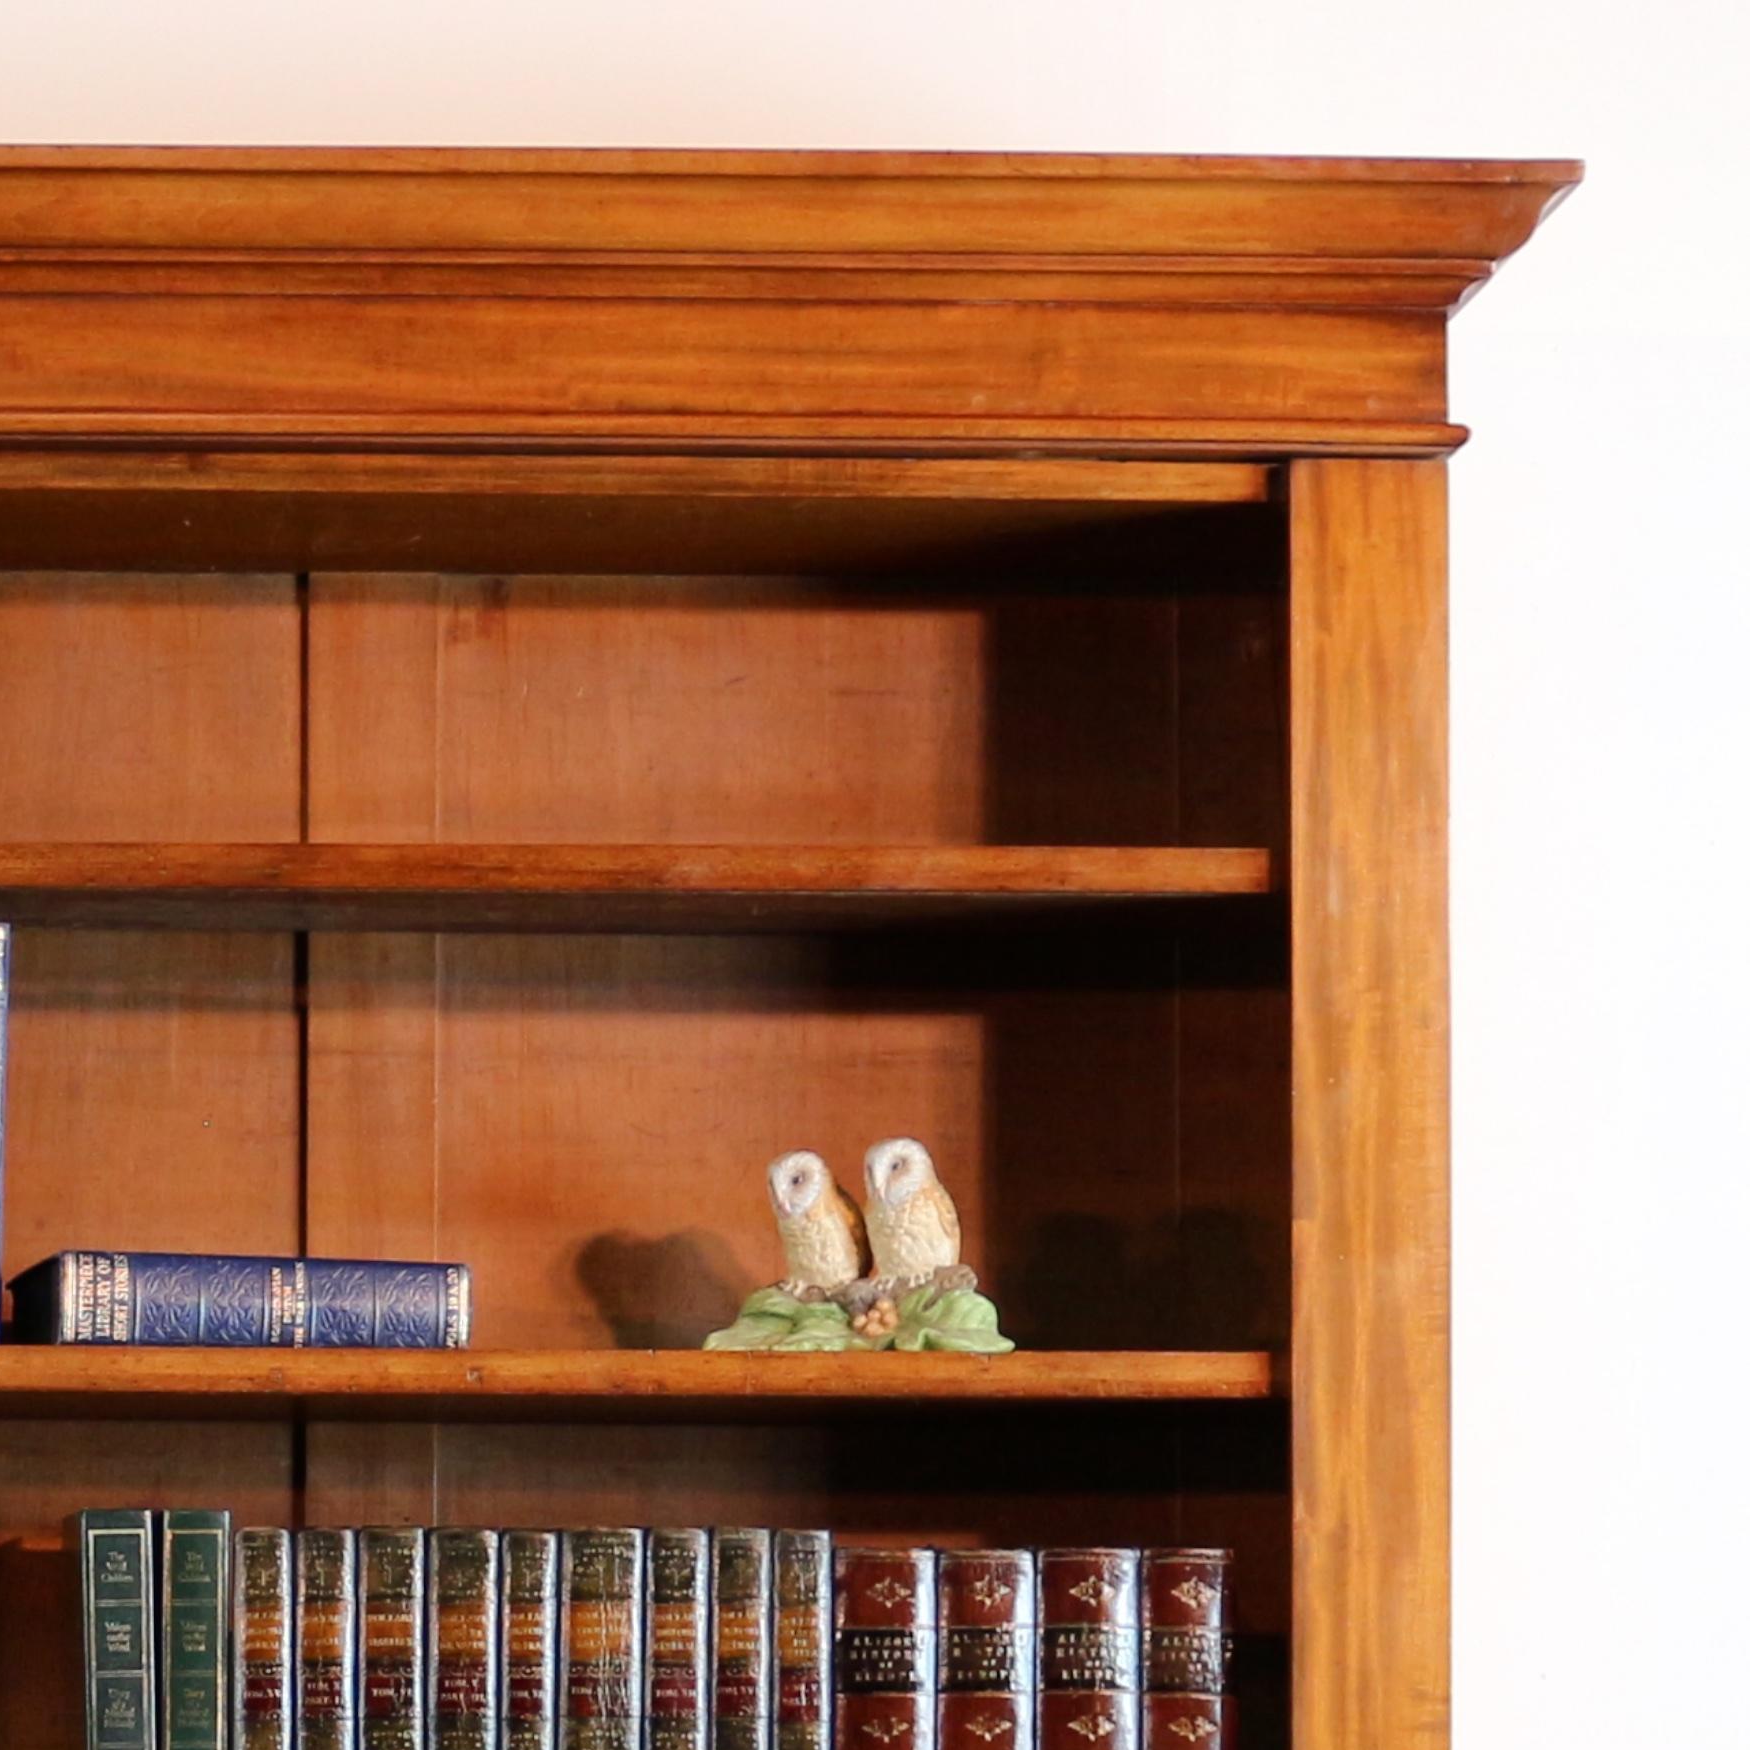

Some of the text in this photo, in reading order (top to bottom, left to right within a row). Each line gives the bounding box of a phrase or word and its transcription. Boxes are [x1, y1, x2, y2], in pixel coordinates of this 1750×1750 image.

[78, 1254, 94, 1341] MASTERPIECE
[96, 1256, 111, 1337] LIBRARY OF
[113, 1254, 130, 1342] SHORT STORIES
